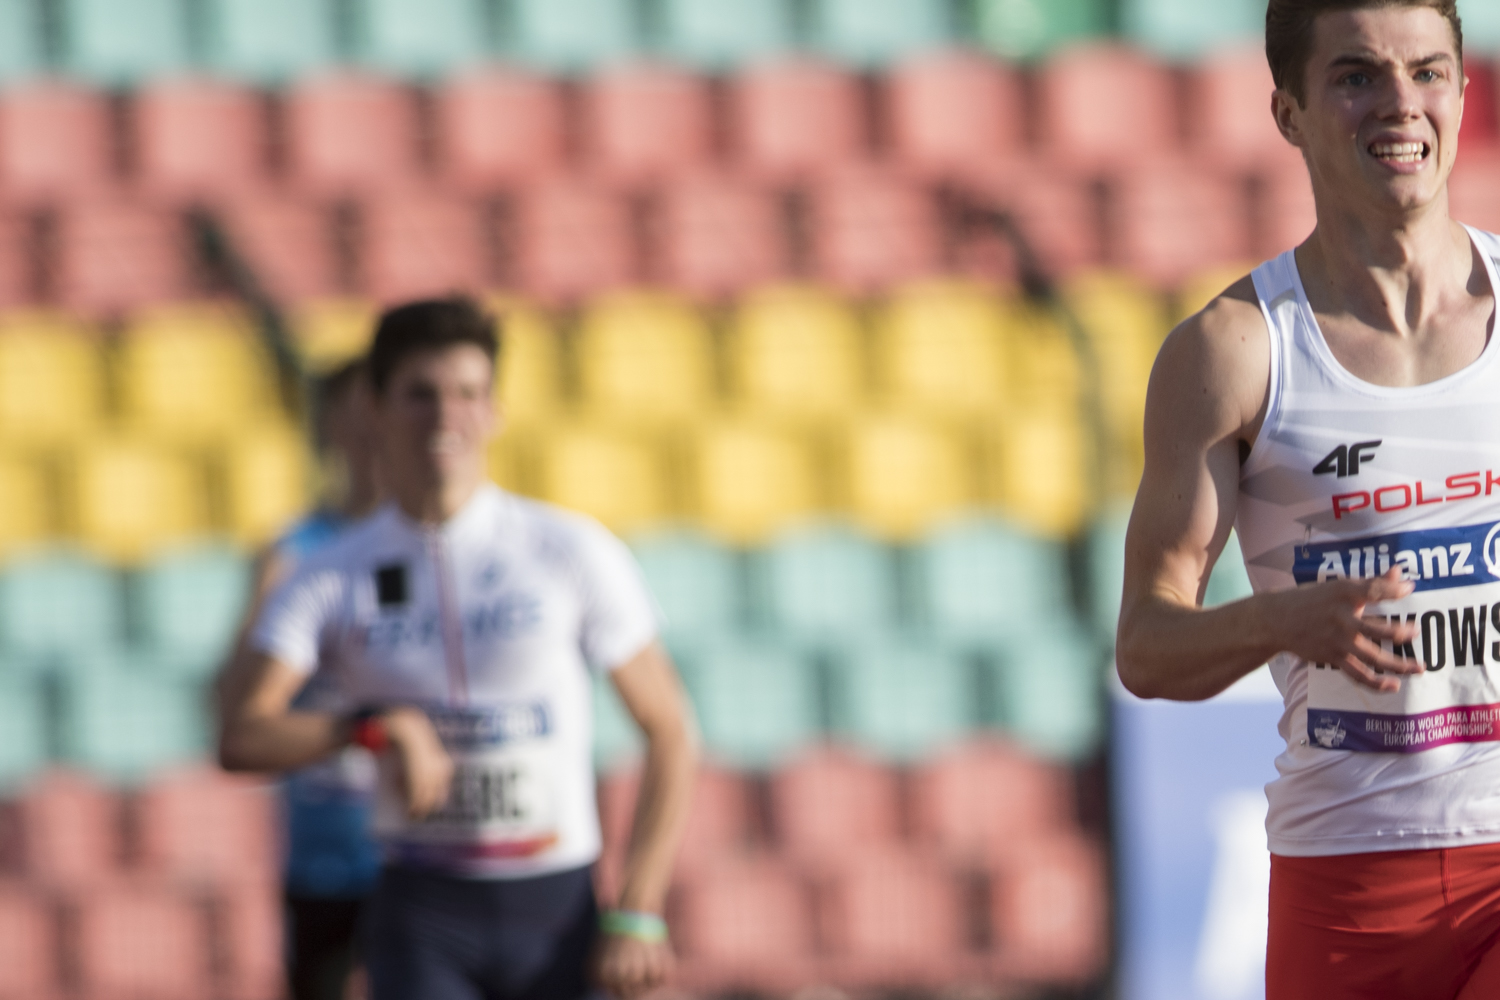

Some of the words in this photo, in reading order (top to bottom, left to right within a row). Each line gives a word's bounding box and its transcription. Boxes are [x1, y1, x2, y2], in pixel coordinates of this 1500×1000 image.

[1312, 438, 1383, 478] 4F
[1316, 541, 1475, 583] Allianz
[1365, 718, 1392, 733] BERLIN
[1394, 718, 1416, 733] 2018
[1446, 710, 1468, 725] PARA
[1384, 730, 1426, 746] EUROPEAN
[1427, 721, 1493, 742] CHAMPIONSHIPS
